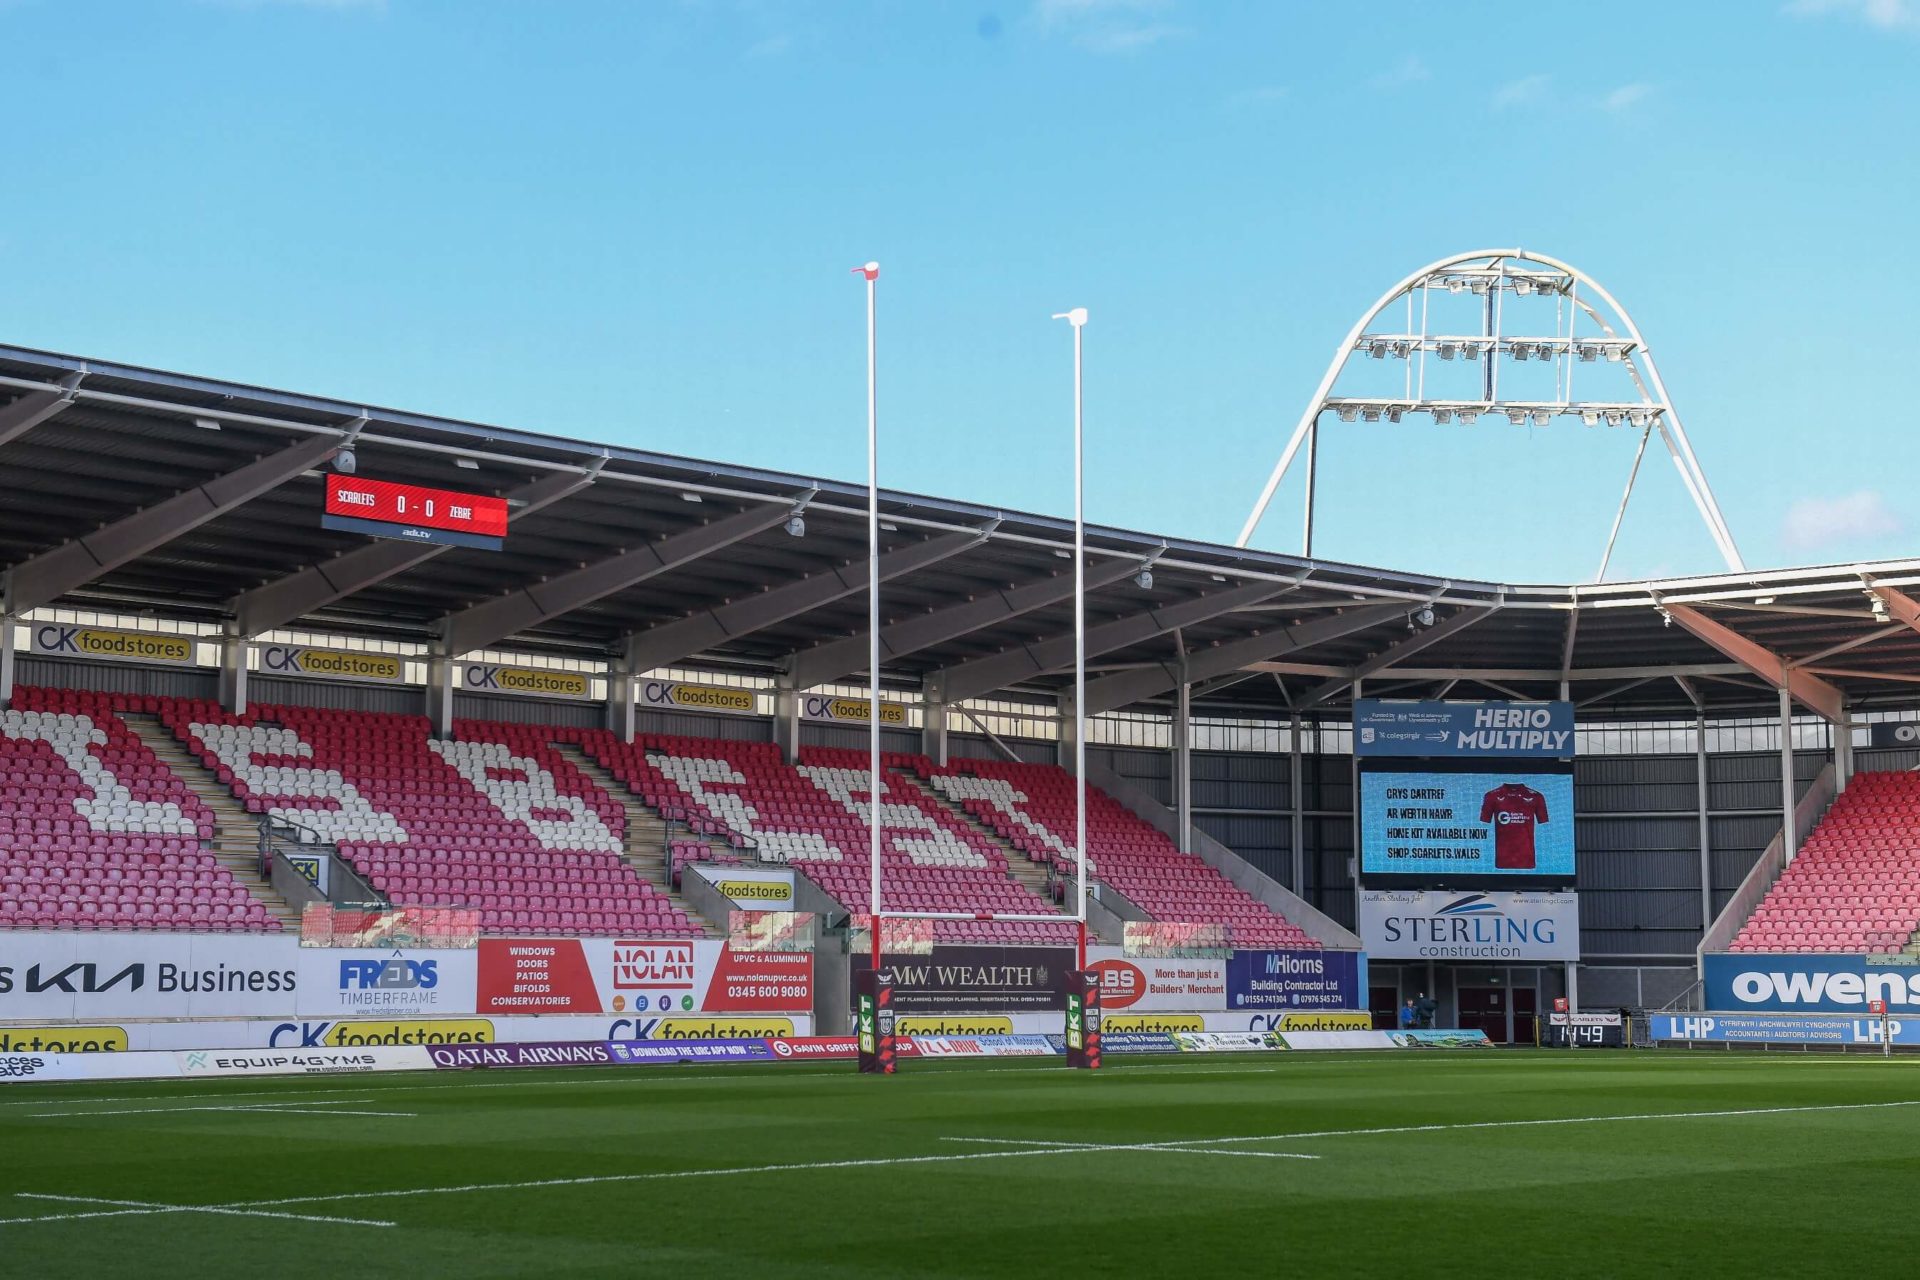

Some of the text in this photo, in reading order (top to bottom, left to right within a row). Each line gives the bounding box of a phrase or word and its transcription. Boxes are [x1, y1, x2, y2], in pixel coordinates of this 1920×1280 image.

[338, 490, 375, 507] SCARLETS
[397, 496, 405, 513] 0
[425, 500, 434, 517] 0
[450, 505, 472, 520] ZEBRE
[38, 626, 184, 657] CK foodstores
[265, 647, 395, 675] CK foodstores
[467, 665, 582, 692] CK foodstores
[646, 682, 749, 709] CK foodstores
[807, 697, 901, 721] CK foodsres
[1474, 709, 1550, 729] HERIO
[1457, 730, 1570, 750] MULTIPLY
[1387, 809, 1453, 819] AR WERTH NAWR
[1387, 828, 1488, 840] HOME KIT AVAILABLE NOW
[721, 883, 788, 898] foodstores
[1384, 917, 1555, 943] STERLING
[510, 947, 556, 956] WINDOWS
[1419, 944, 1521, 958] construction
[517, 960, 549, 968] DOORS
[613, 949, 694, 979] NOLAN
[733, 955, 808, 964] UPVC & ALUMINIUM
[25, 962, 145, 993] KIA
[158, 963, 297, 993] Business
[340, 959, 438, 989] FREDS
[516, 972, 549, 980] PATIOS
[726, 974, 808, 984] www.nolanupvc.co.uk
[936, 966, 1033, 985] WEALTH
[1100, 970, 1134, 987] BS
[1155, 969, 1175, 978] More
[1178, 969, 1195, 978] than
[1196, 969, 1212, 980] just
[514, 984, 551, 993] BIFOLDS
[728, 986, 807, 997] 0345 600 9080
[1150, 984, 1224, 994] Builders' Merchant
[1251, 980, 1338, 992] Building Contractor Ltd
[340, 992, 437, 1005] TIMBERFRAME
[491, 996, 571, 1006] CONSERVATORIES
[1245, 995, 1264, 1003] 01554
[861, 996, 872, 1051] BKT
[1069, 995, 1079, 1047] BKT
[1105, 1020, 1198, 1032] foodstores
[1250, 1014, 1367, 1031] CK foodstores
[1670, 1018, 1714, 1038] LHP
[269, 1022, 485, 1047] CK foodstores
[609, 1018, 786, 1040] CK foodstores
[899, 1022, 1006, 1035] foodstores
[1810, 1031, 1842, 1039] ADVISORS
[1853, 1020, 1902, 1042] LHP
[632, 1047, 677, 1057] DOWNLOAD
[678, 1047, 695, 1056] THE
[694, 1046, 712, 1055] URC
[711, 1046, 727, 1055] APP
[728, 1045, 747, 1054] NOW
[793, 1044, 825, 1052] GAVIN
[827, 1043, 858, 1052] GRIFFI
[949, 1040, 984, 1053] DRIVE
[0, 1057, 44, 1068] nces
[216, 1055, 376, 1069] EQUIP4GYMS
[434, 1046, 608, 1067] QATAR AIRWAYS
[0, 1064, 35, 1077] ate
